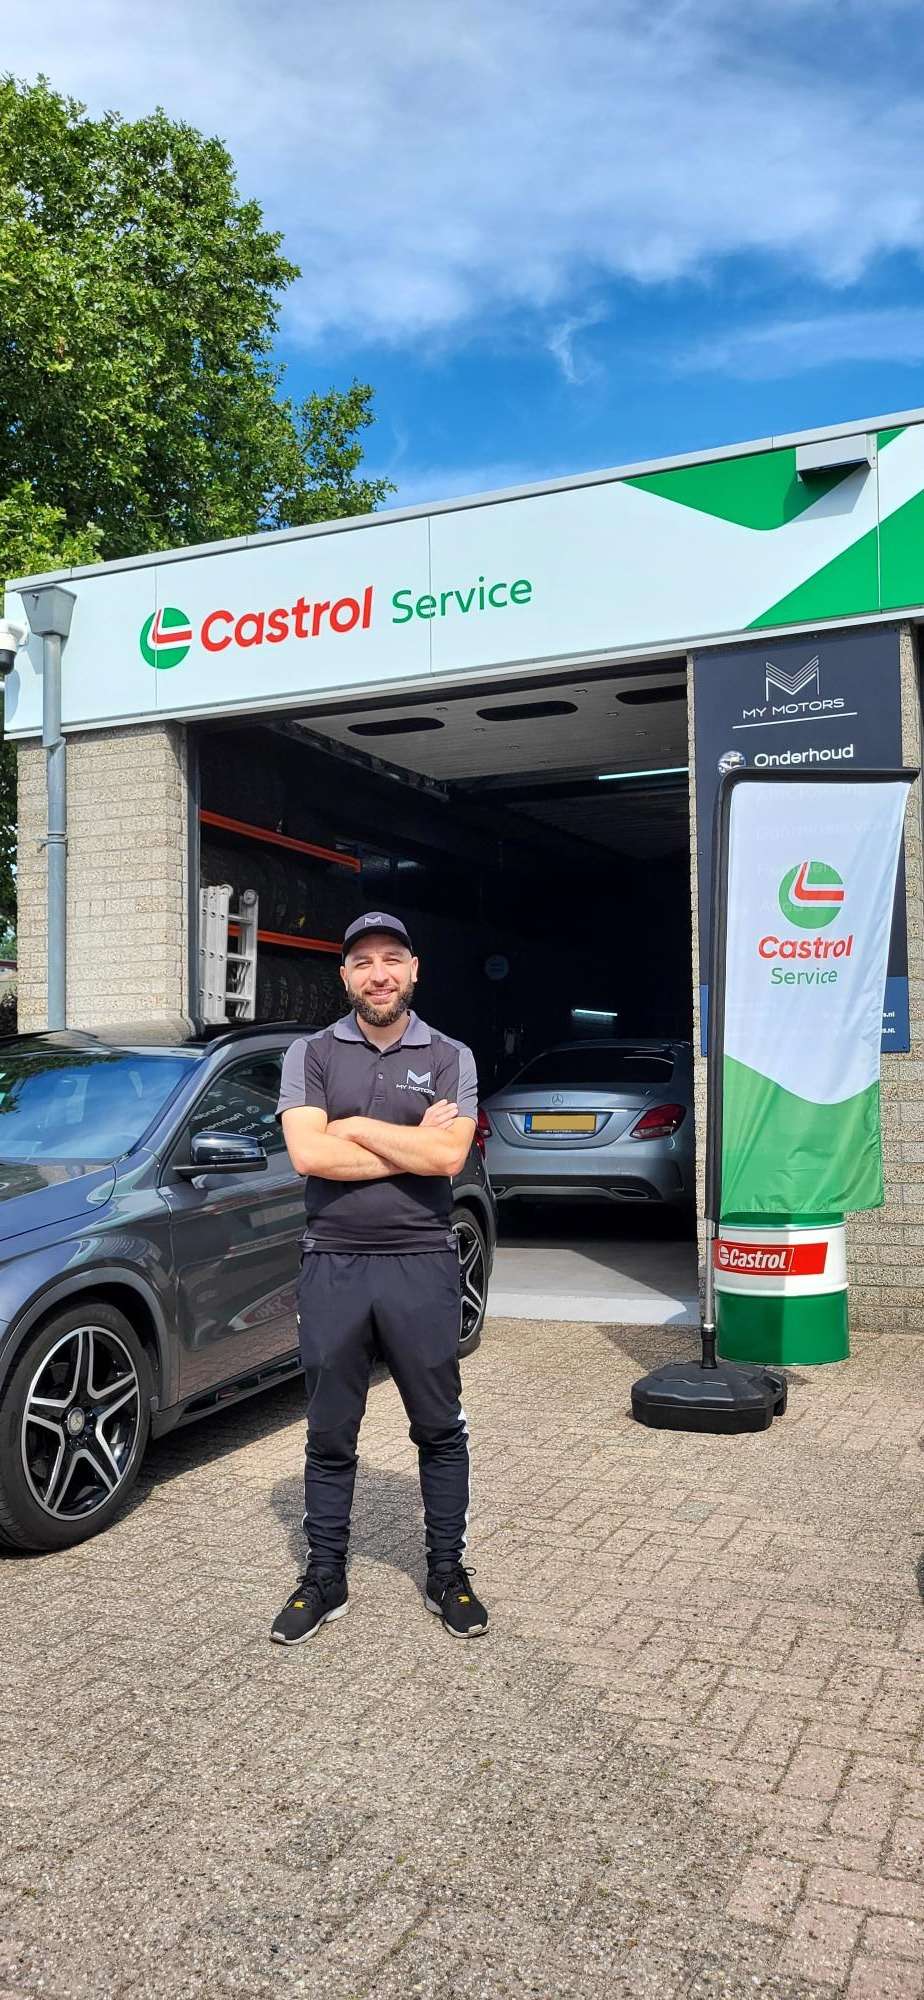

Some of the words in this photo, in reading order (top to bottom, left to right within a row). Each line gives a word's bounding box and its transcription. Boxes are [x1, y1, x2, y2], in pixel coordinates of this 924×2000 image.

[201, 585, 373, 652] Castrol
[392, 576, 532, 624] Service
[742, 707, 767, 719] MY
[772, 698, 845, 716] MOTORS
[754, 743, 854, 767] Onderhoud
[758, 934, 853, 959] Castrol
[770, 966, 838, 985] Service
[729, 1248, 787, 1270] Castrol
